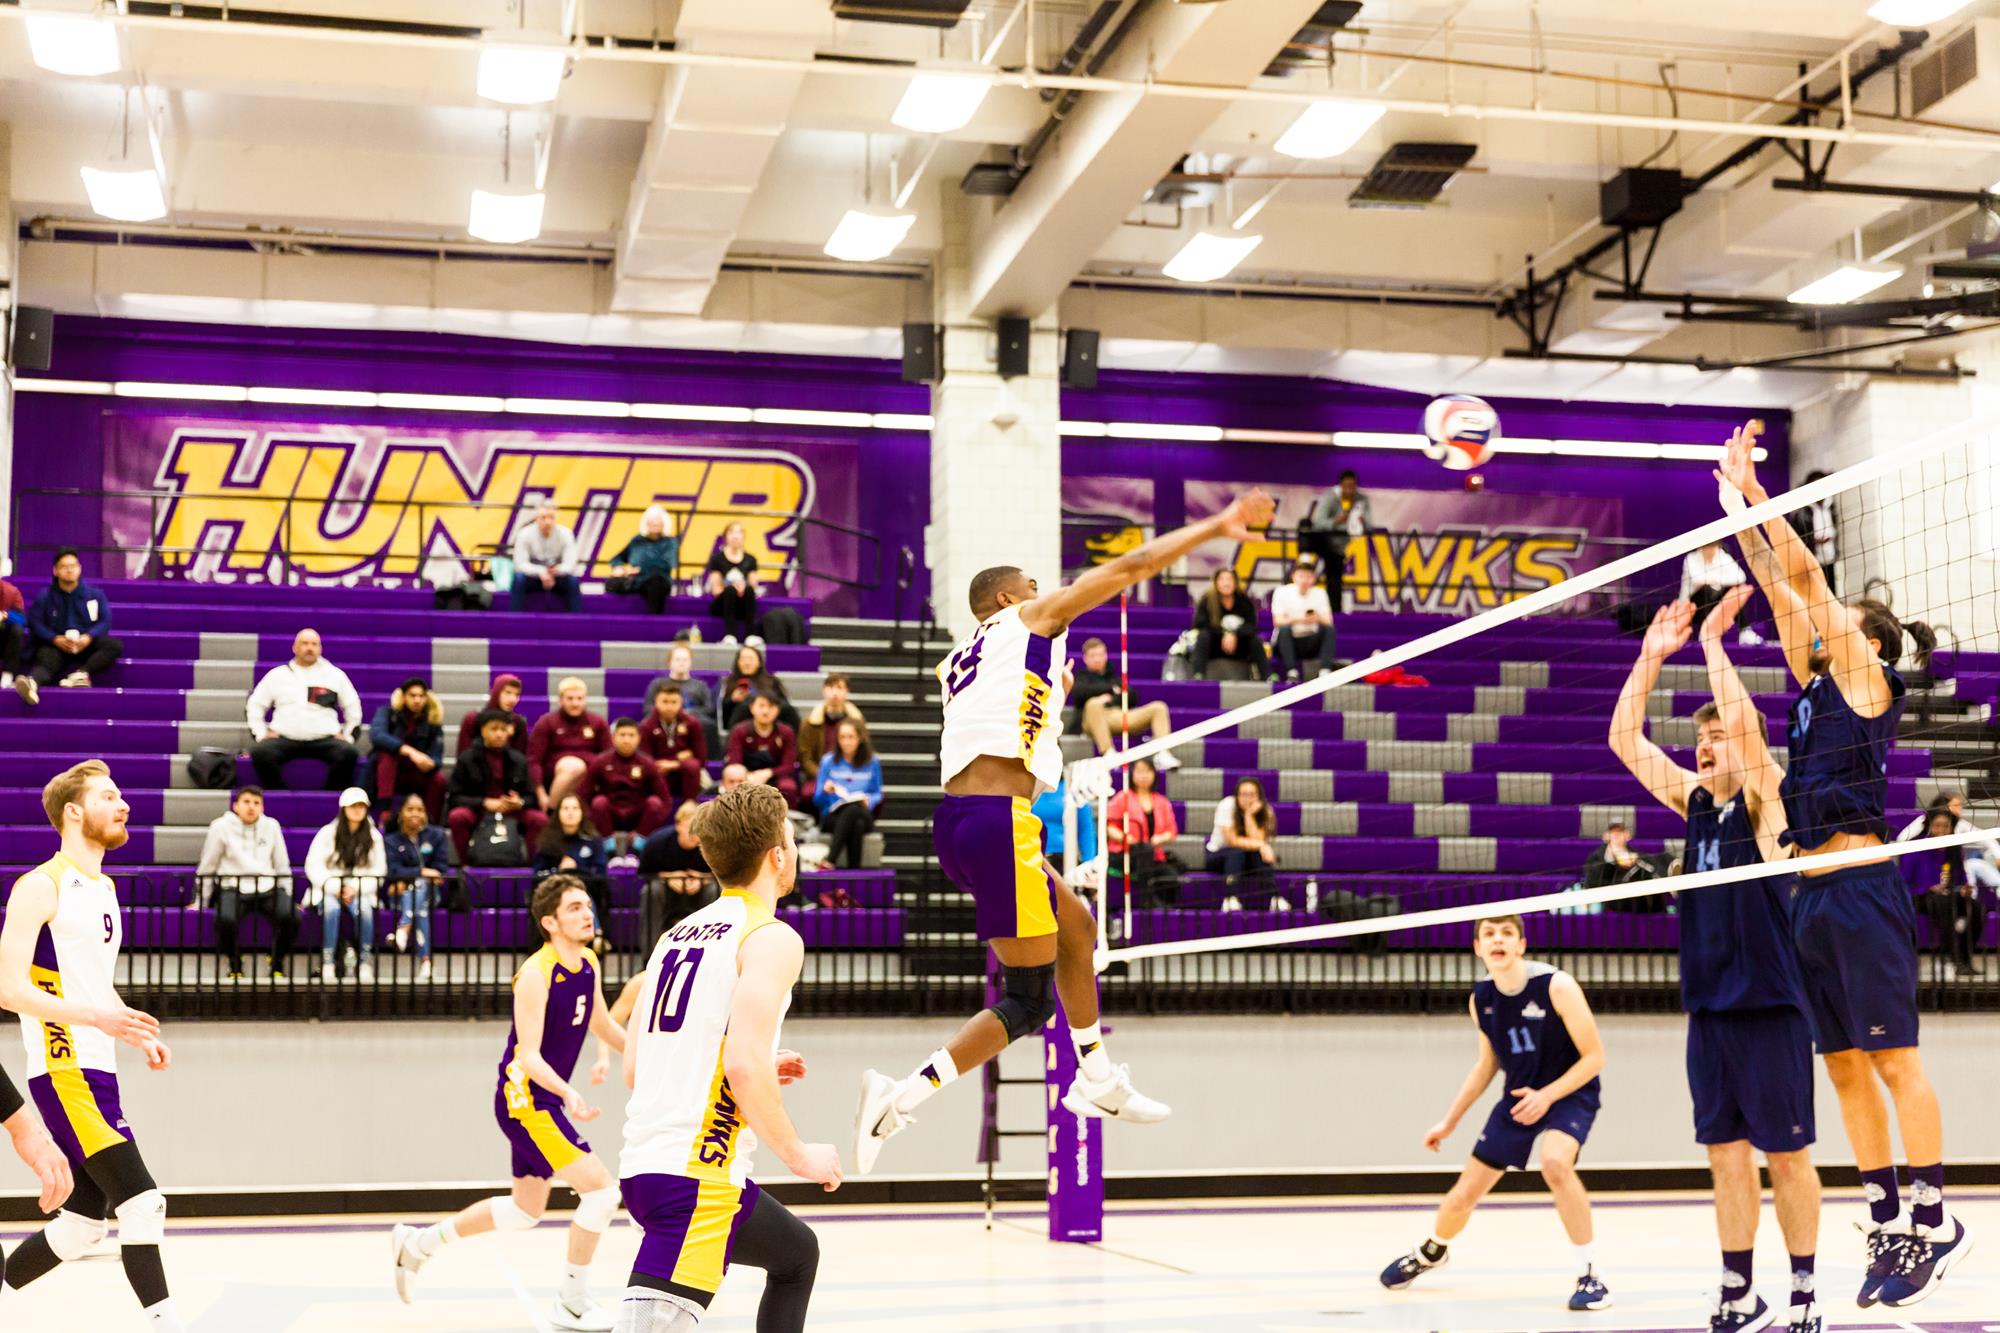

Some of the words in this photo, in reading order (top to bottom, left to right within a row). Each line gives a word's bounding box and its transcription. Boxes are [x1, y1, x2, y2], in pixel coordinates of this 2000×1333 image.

[155, 430, 813, 584] HUNTER
[1696, 838, 1720, 872] 14
[103, 913, 114, 943] 9
[661, 922, 733, 944] HUNTER
[648, 947, 704, 1033] 10
[37, 980, 71, 1060] HWKS
[571, 994, 587, 1027] 5
[1507, 1026, 1536, 1054] 11
